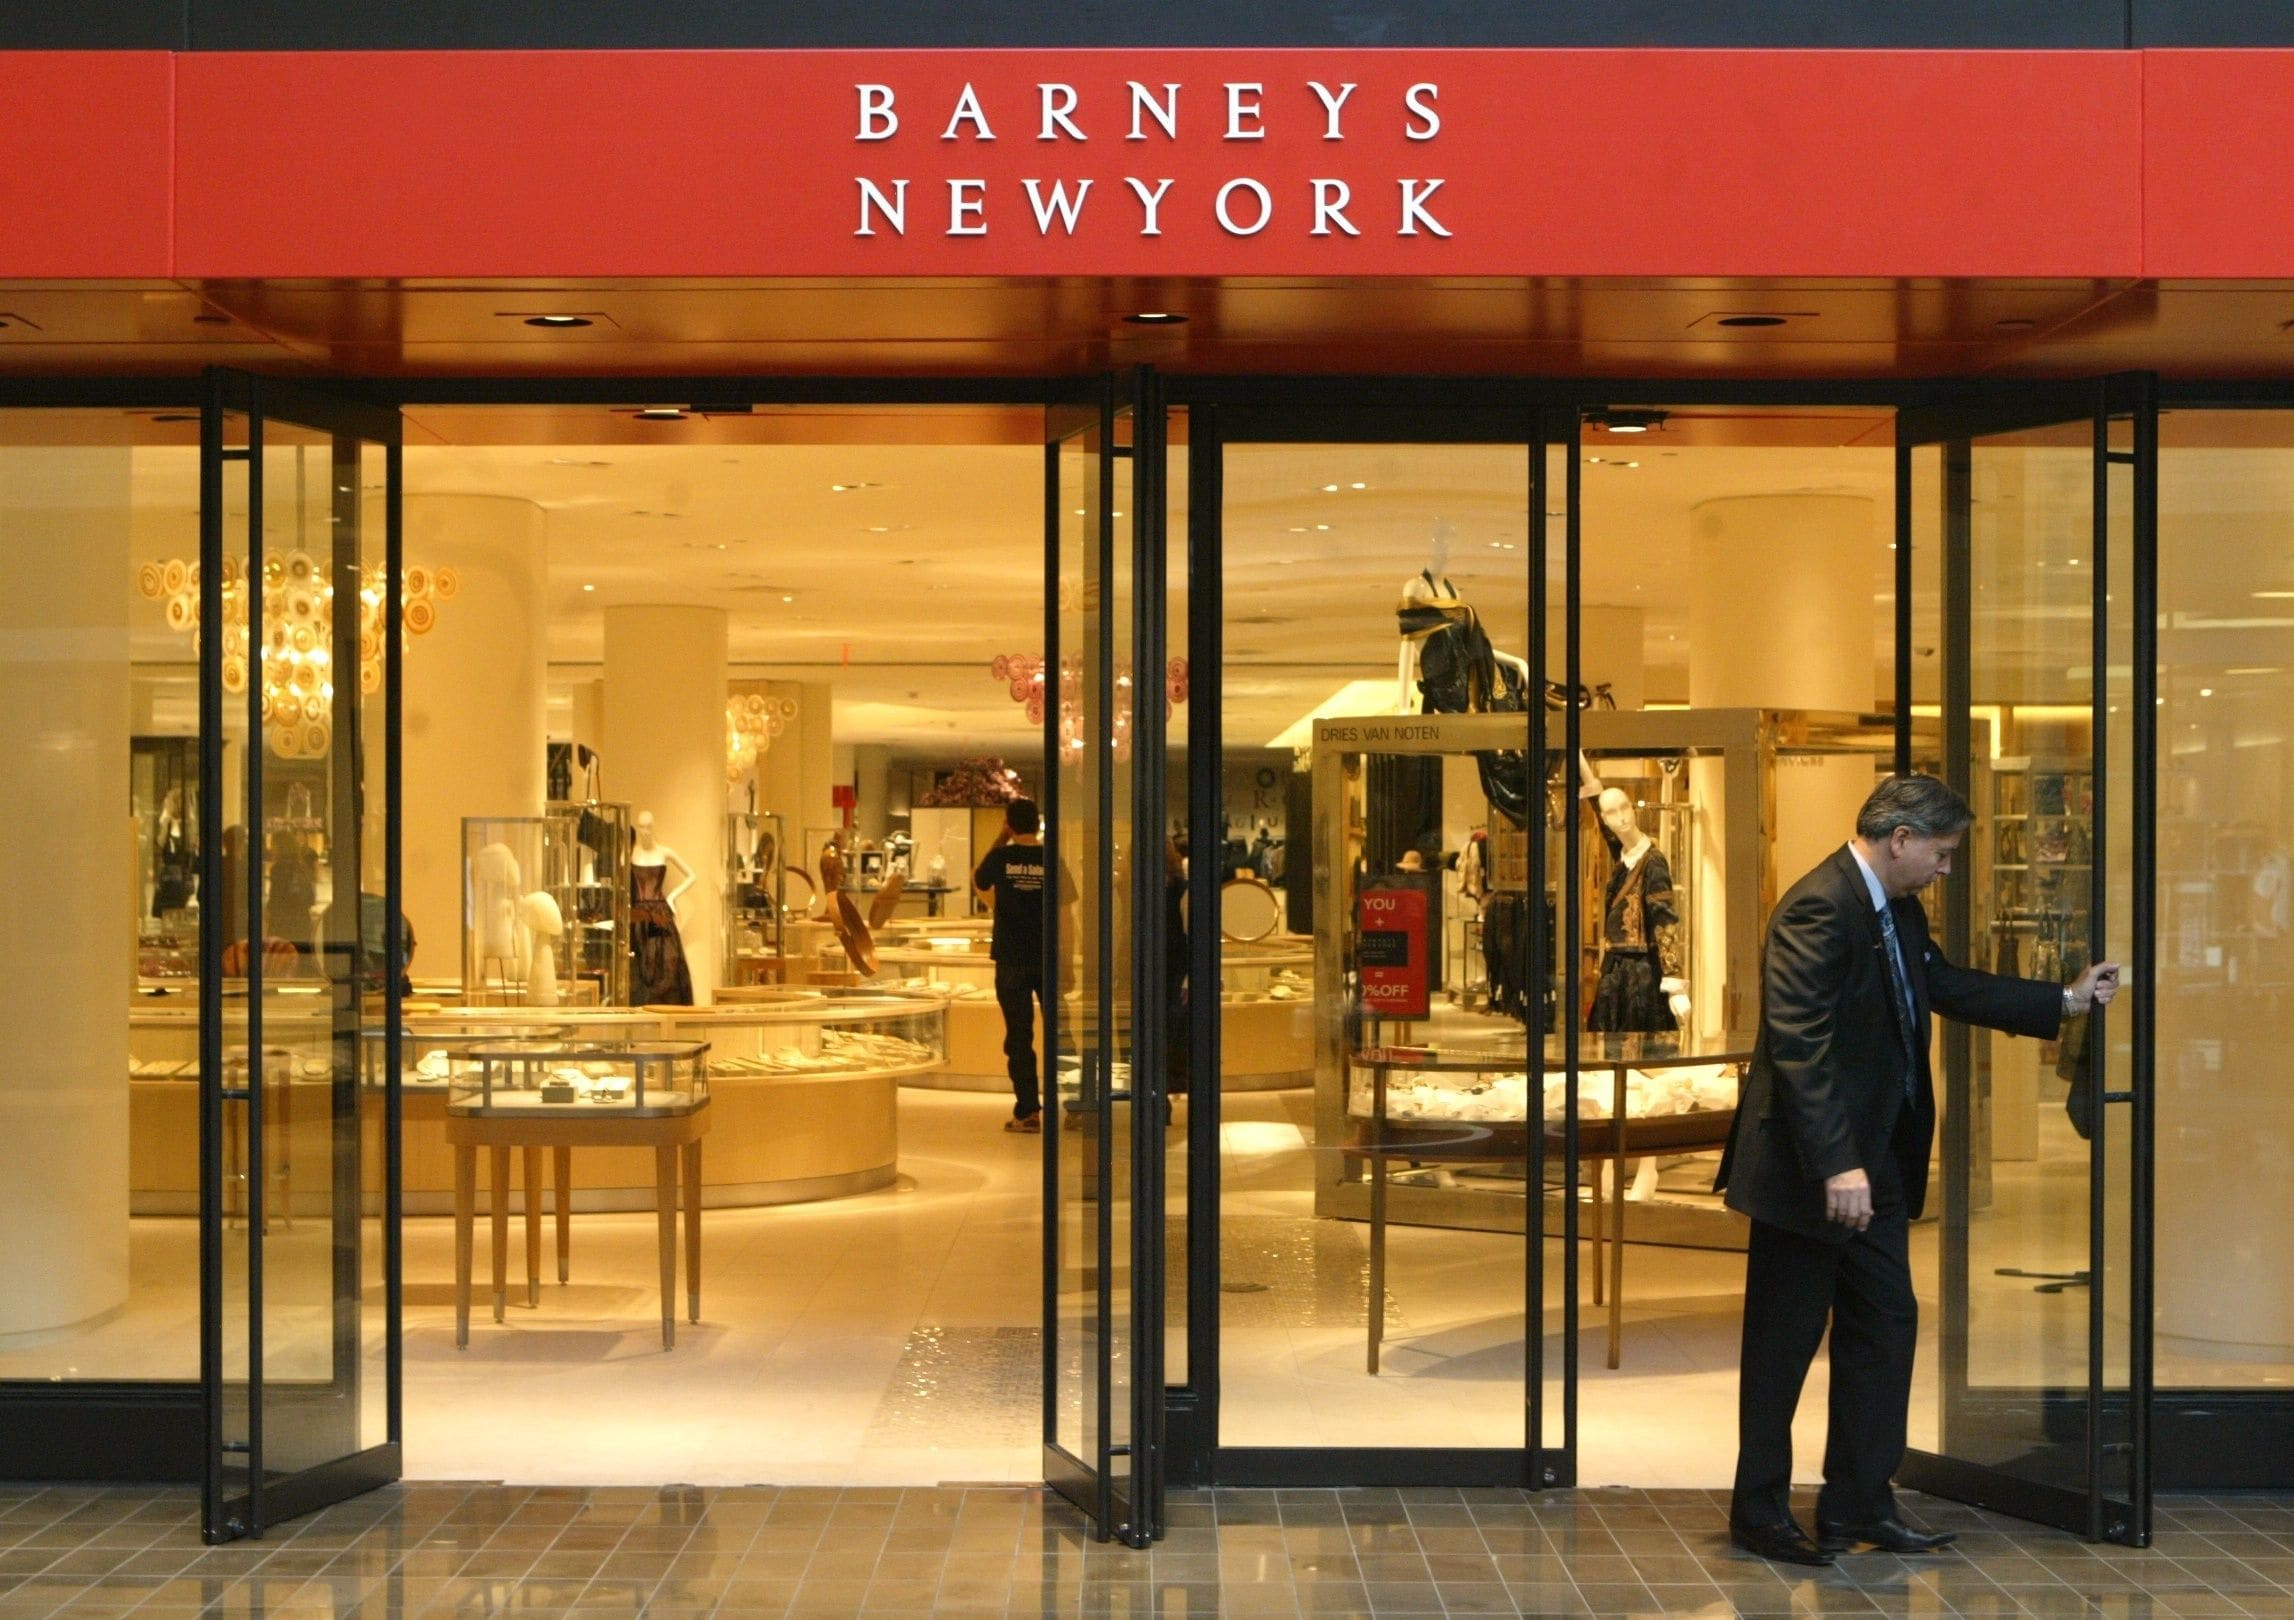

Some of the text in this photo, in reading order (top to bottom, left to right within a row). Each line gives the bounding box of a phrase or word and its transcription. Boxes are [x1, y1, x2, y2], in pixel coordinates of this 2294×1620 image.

[854, 81, 1441, 140] BARNEYS
[1321, 726, 1440, 742] DRIES VAN NOTEN
[1364, 898, 1396, 911] YOU
